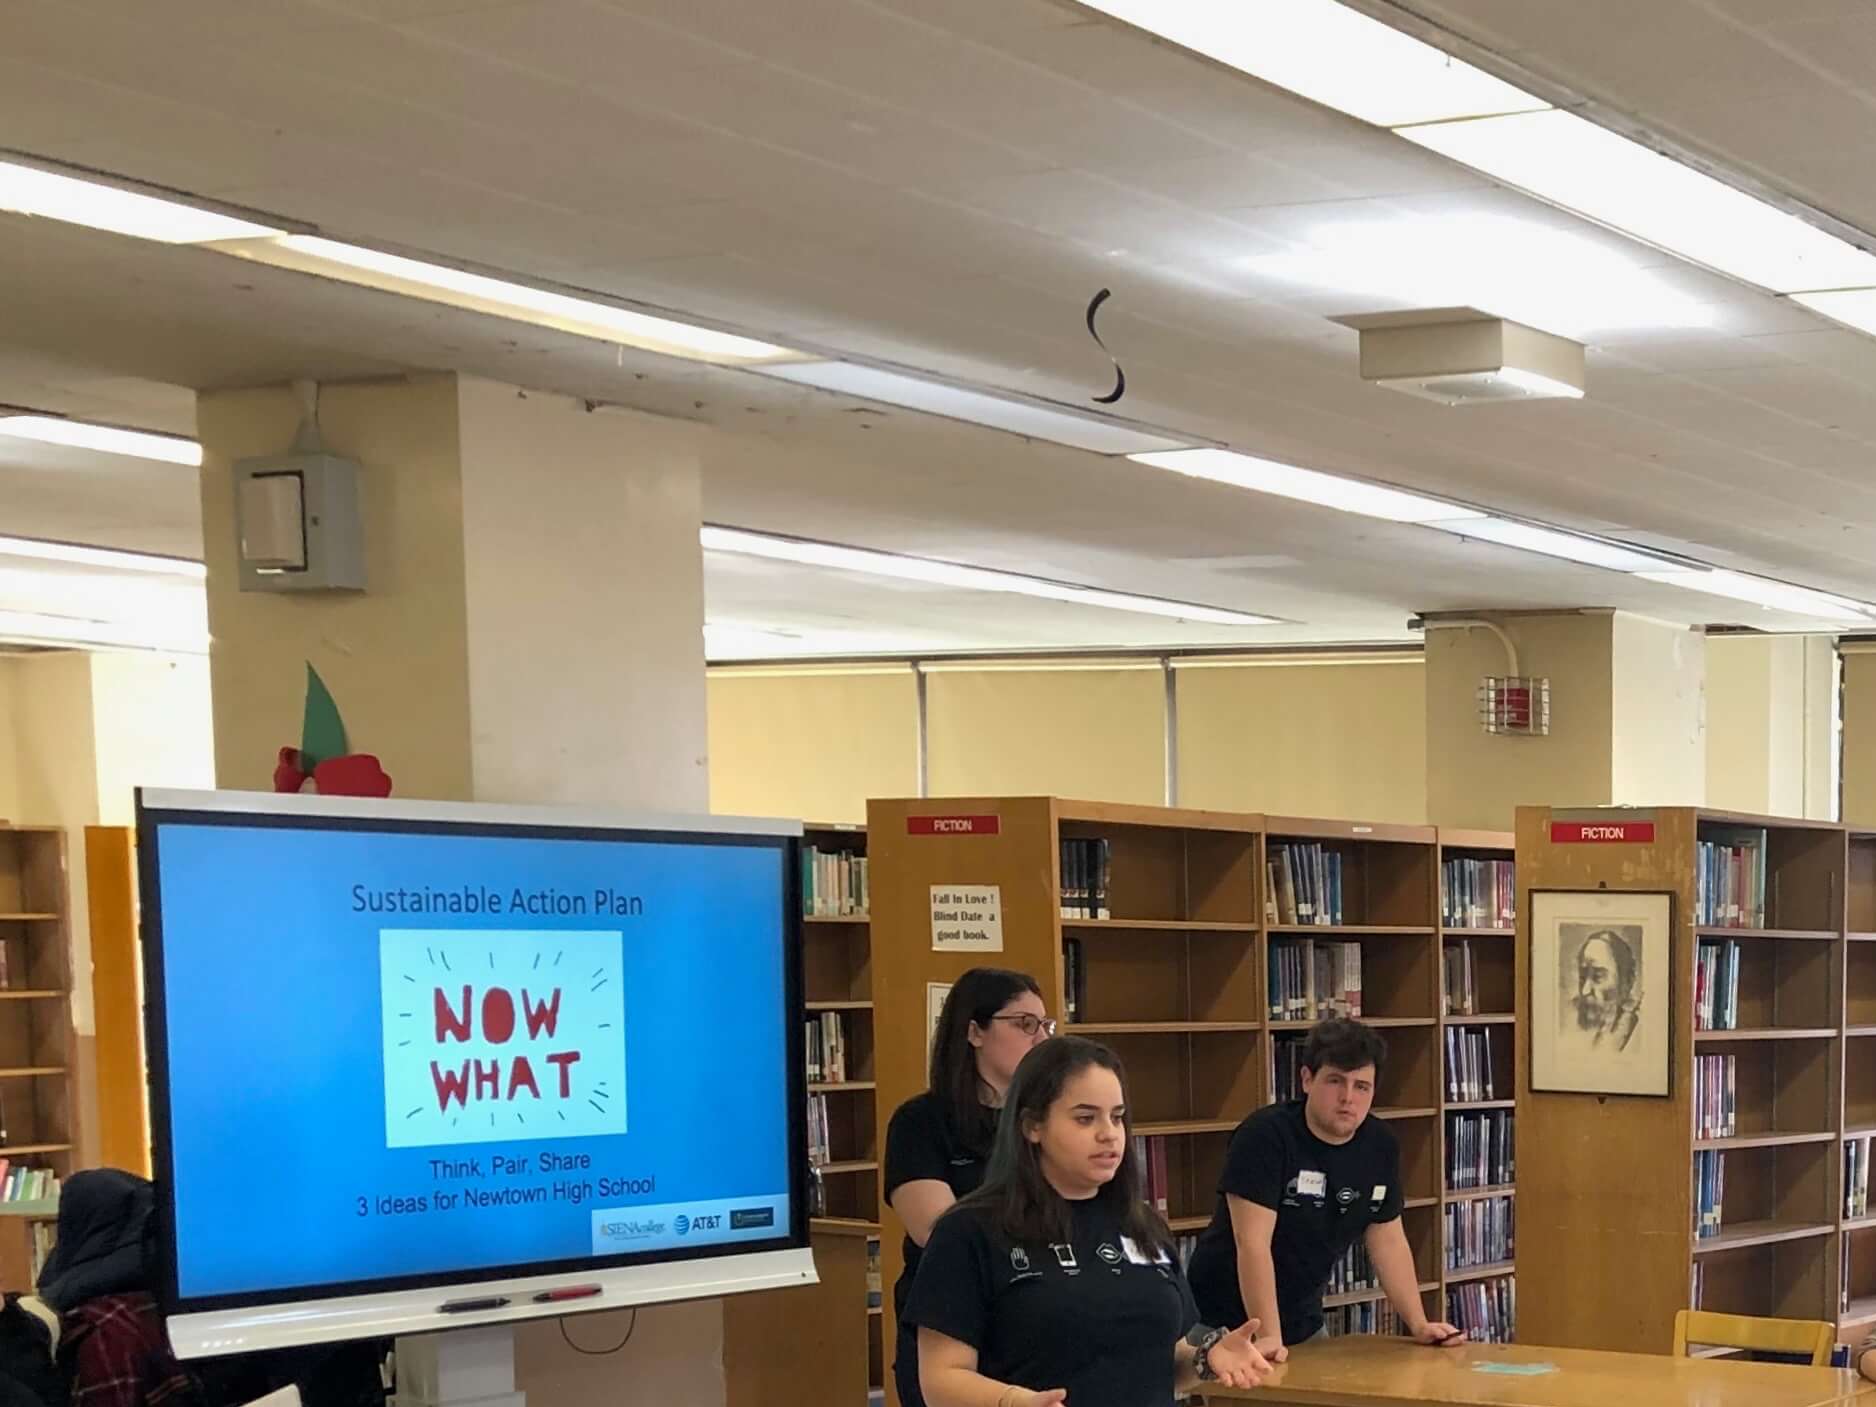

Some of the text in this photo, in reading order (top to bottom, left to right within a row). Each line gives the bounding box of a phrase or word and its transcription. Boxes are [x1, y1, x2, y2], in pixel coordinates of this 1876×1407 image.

[933, 819, 973, 832] FICTION
[1581, 827, 1624, 840] FICTION
[352, 884, 643, 916] Sustainable Action Plan
[932, 893, 950, 904] Fall
[965, 894, 987, 904] Love
[933, 911, 995, 922] Blind Date a
[937, 930, 960, 942] good
[434, 984, 562, 1044] NOW
[429, 1051, 581, 1115] WHAT
[429, 1151, 591, 1181] Think, Pair, Share
[356, 1175, 656, 1217] 3 Ideas for Newtown High School
[691, 1215, 722, 1232] AT&T
